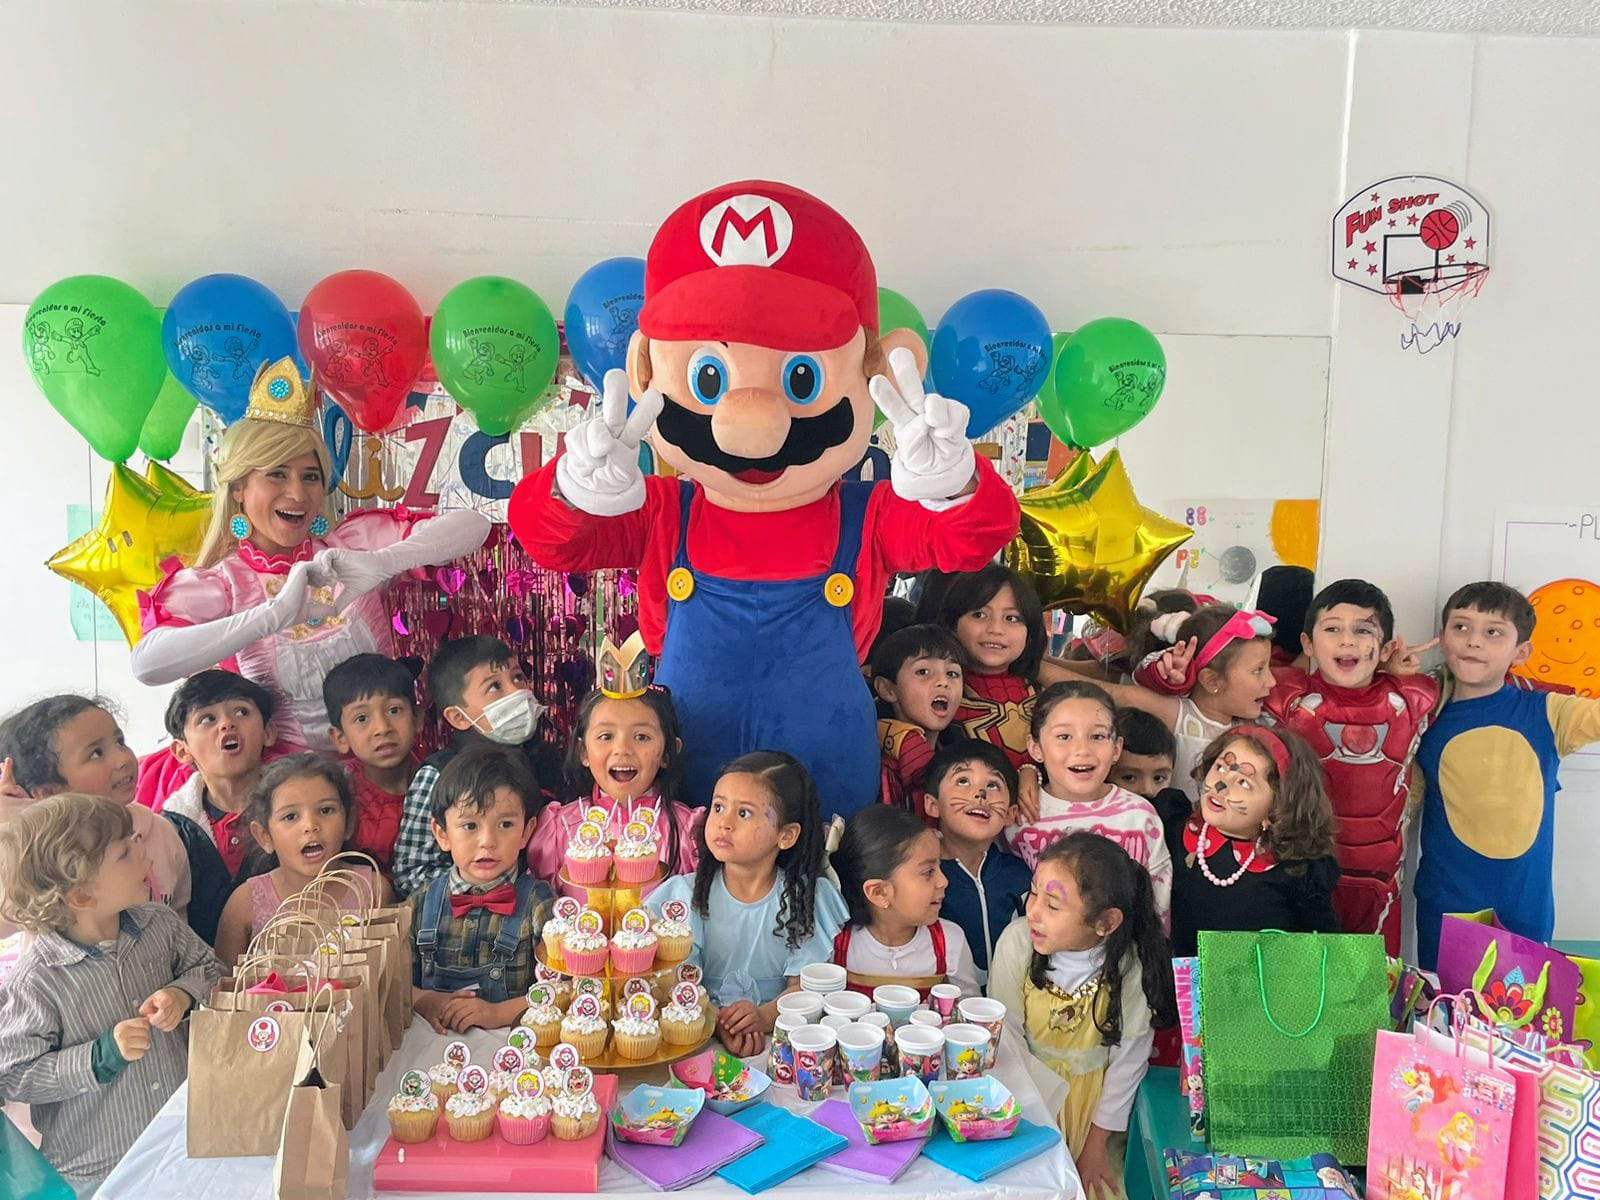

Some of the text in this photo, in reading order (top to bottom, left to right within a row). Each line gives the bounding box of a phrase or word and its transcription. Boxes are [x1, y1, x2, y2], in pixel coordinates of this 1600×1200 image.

[711, 205, 779, 259] M
[1345, 193, 1440, 248] FUN SHOT
[70, 305, 82, 313] mi
[223, 323, 234, 331] mi
[462, 325, 508, 338] Bienvenidos
[516, 332, 526, 340] mi
[1174, 965, 1193, 1044] MINNIE
